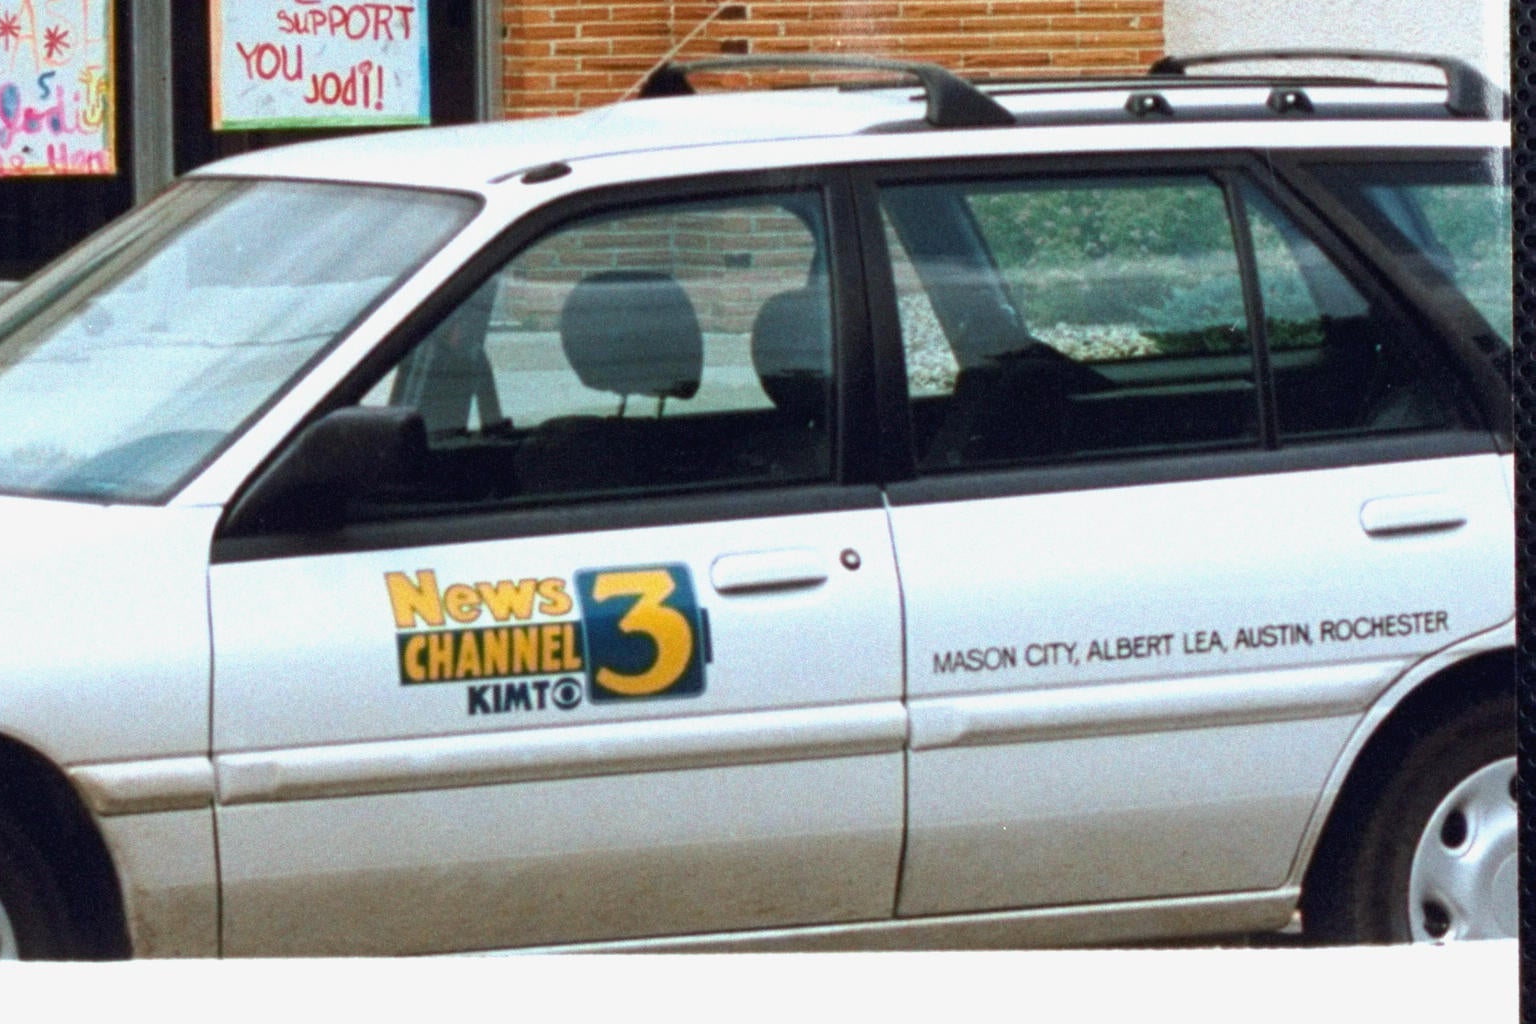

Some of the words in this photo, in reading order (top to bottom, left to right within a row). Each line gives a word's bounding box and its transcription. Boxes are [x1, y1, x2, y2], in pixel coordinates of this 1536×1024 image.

[235, 41, 303, 82] YOU
[383, 568, 574, 629] News
[404, 622, 582, 683] CHANNEL
[592, 569, 693, 696] 3
[933, 646, 1017, 674] MASON
[1025, 640, 1081, 667] CITY,
[1087, 633, 1175, 662] ALBERT
[1182, 628, 1228, 656] LEA,
[1234, 621, 1314, 650] AUSTIN,
[1321, 610, 1450, 641] ROCHESTER
[467, 682, 551, 716] KIMT
